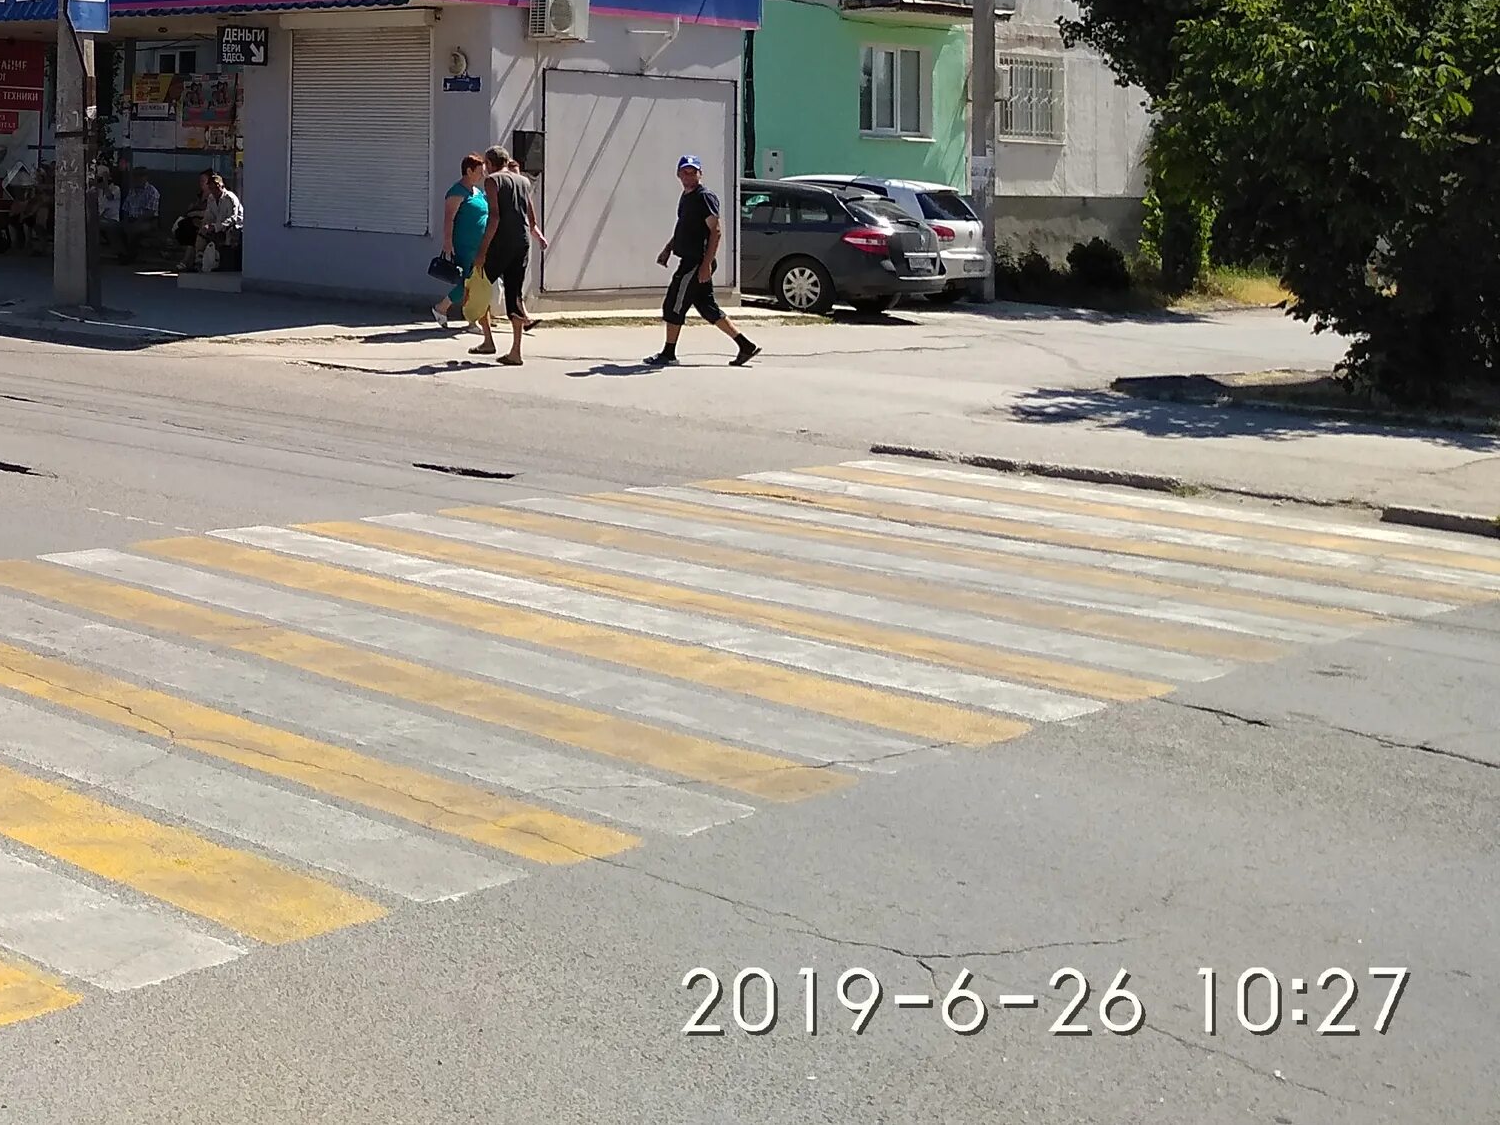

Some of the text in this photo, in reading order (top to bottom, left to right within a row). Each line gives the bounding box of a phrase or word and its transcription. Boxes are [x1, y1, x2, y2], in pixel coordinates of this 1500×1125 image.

[222, 28, 266, 43] ДЕНЬГИ
[222, 43, 241, 52] БЕРИ
[222, 53, 245, 63] ЗДЕСЬ
[3, 91, 39, 101] ТЕХНИКИ
